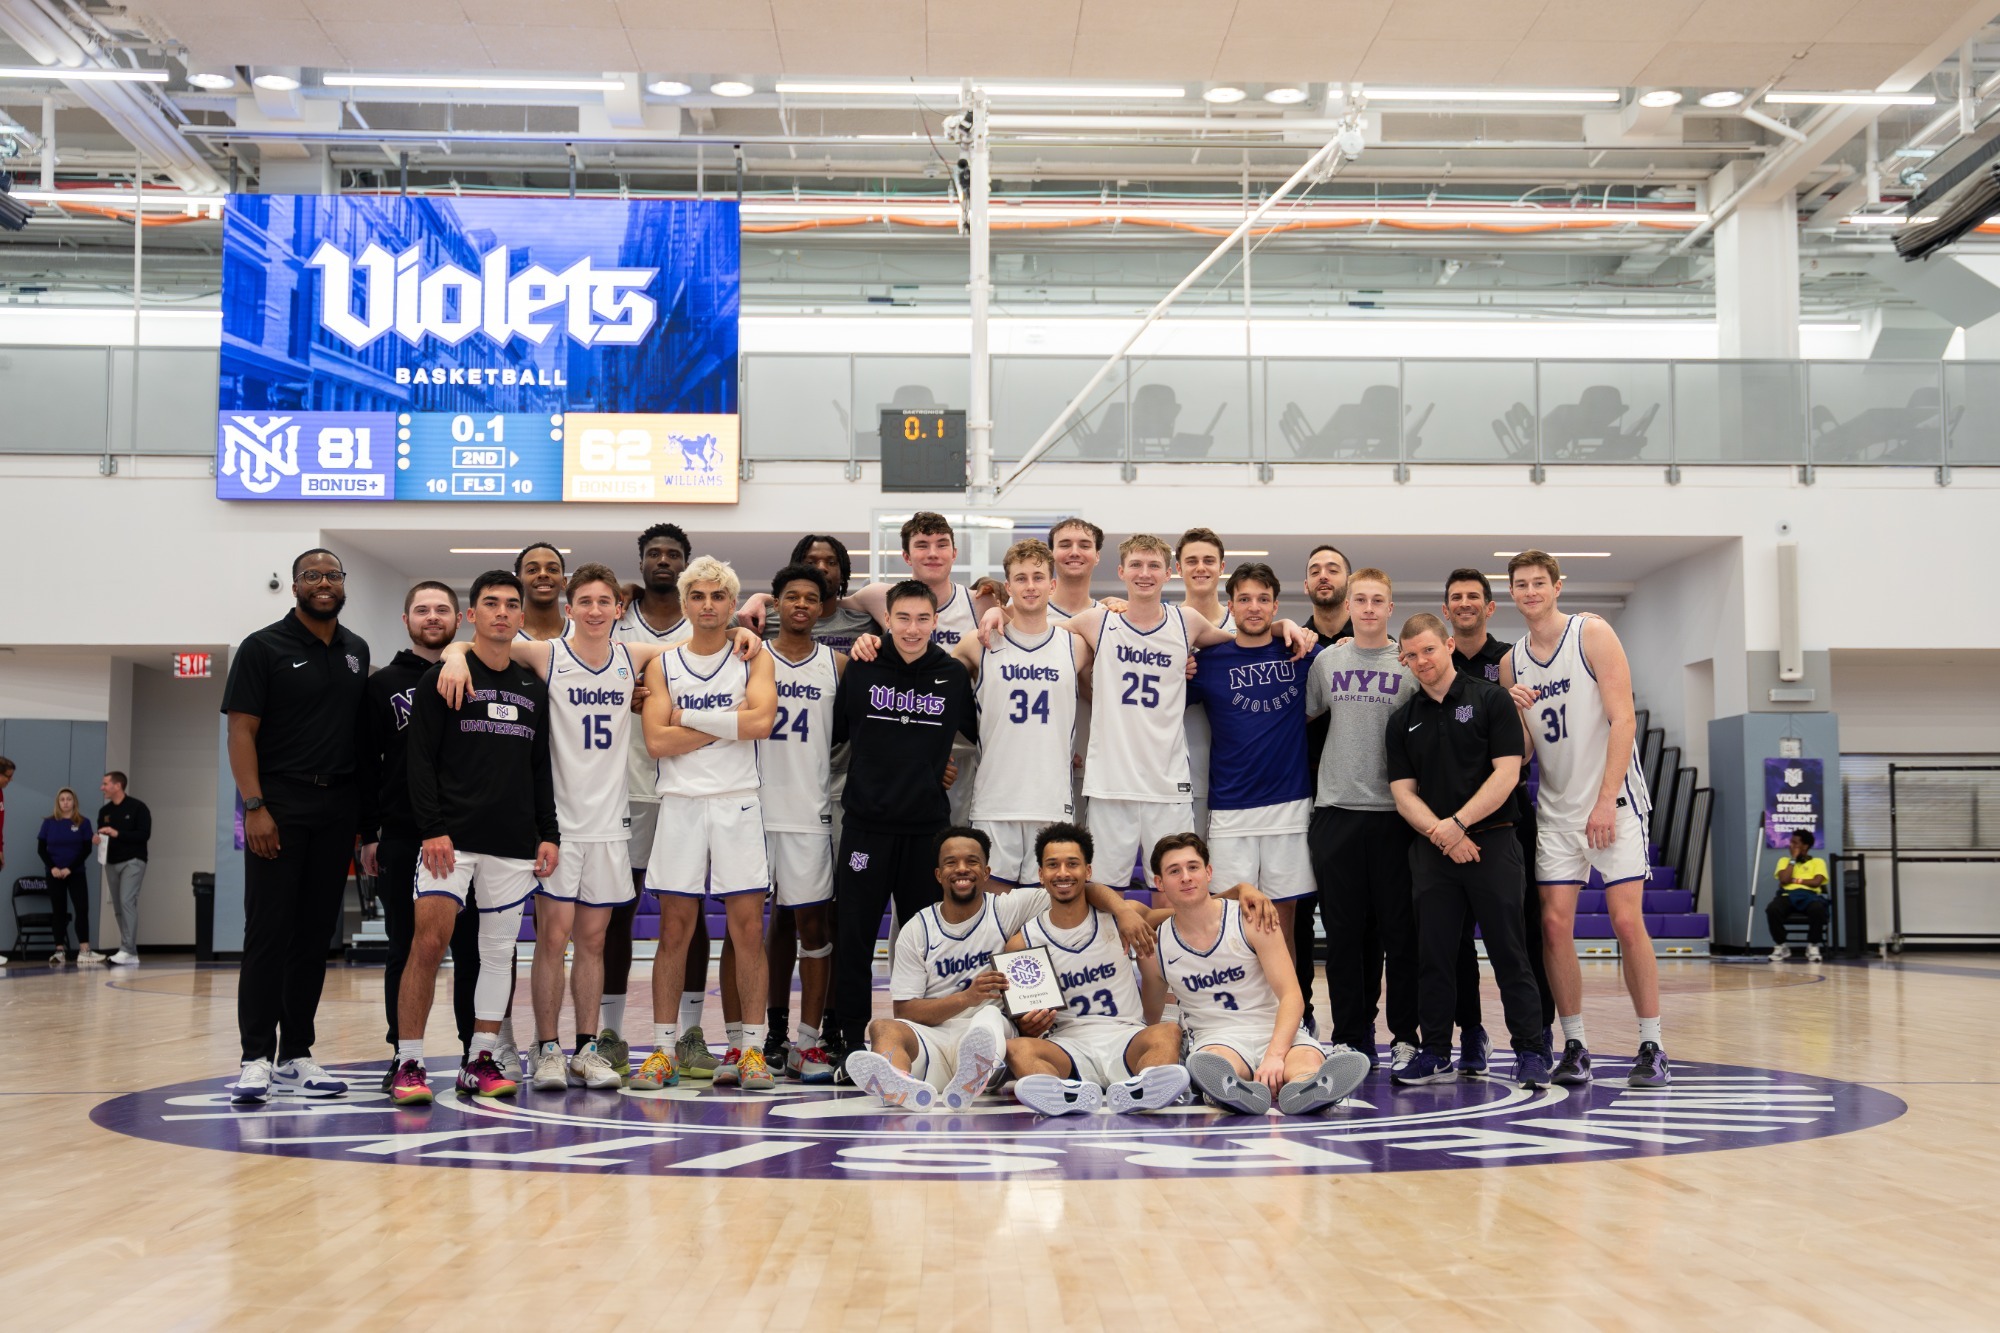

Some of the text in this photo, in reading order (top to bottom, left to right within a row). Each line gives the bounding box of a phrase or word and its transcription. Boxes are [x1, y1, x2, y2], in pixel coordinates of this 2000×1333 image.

[305, 239, 660, 350] Violets
[395, 367, 567, 386] BASKETBALL
[452, 414, 504, 442] 0.1
[904, 416, 944, 441] 0.1
[318, 427, 373, 469] 81
[461, 451, 498, 465] 2ND
[579, 428, 652, 471] 62
[308, 478, 379, 491] BONUS+
[426, 478, 448, 493] 10
[463, 477, 496, 491] FLS
[511, 479, 533, 493] 10
[579, 480, 648, 493] BONUS+
[664, 475, 724, 486] WILLIAMS
[930, 629, 961, 645] lets
[179, 653, 208, 676] EXIT
[1116, 644, 1173, 668] Violets
[1000, 663, 1060, 682] Violets
[1229, 660, 1296, 689] NYU
[1331, 669, 1403, 696] NYU
[465, 689, 536, 713] NEW YORK
[567, 687, 625, 707] Violets
[677, 691, 733, 710] Violets
[775, 680, 822, 701] iolets
[869, 684, 946, 716] Violets
[1121, 671, 1160, 709] 25
[1232, 685, 1299, 713] VIOLETS
[1333, 694, 1393, 705] BASKETBALL
[1009, 689, 1050, 724] 34
[460, 719, 536, 741] UNIVERSITY
[582, 714, 613, 750] 15
[769, 705, 809, 743] 24
[1540, 703, 1569, 744] 31
[1776, 793, 1812, 802] VIOLET
[1776, 803, 1811, 812] STORM
[1771, 813, 1817, 822] STUDENT
[1059, 962, 1117, 993] Violets
[1181, 965, 1246, 993] Violets
[1069, 988, 1119, 1018] 23
[1213, 991, 1239, 1011] 3
